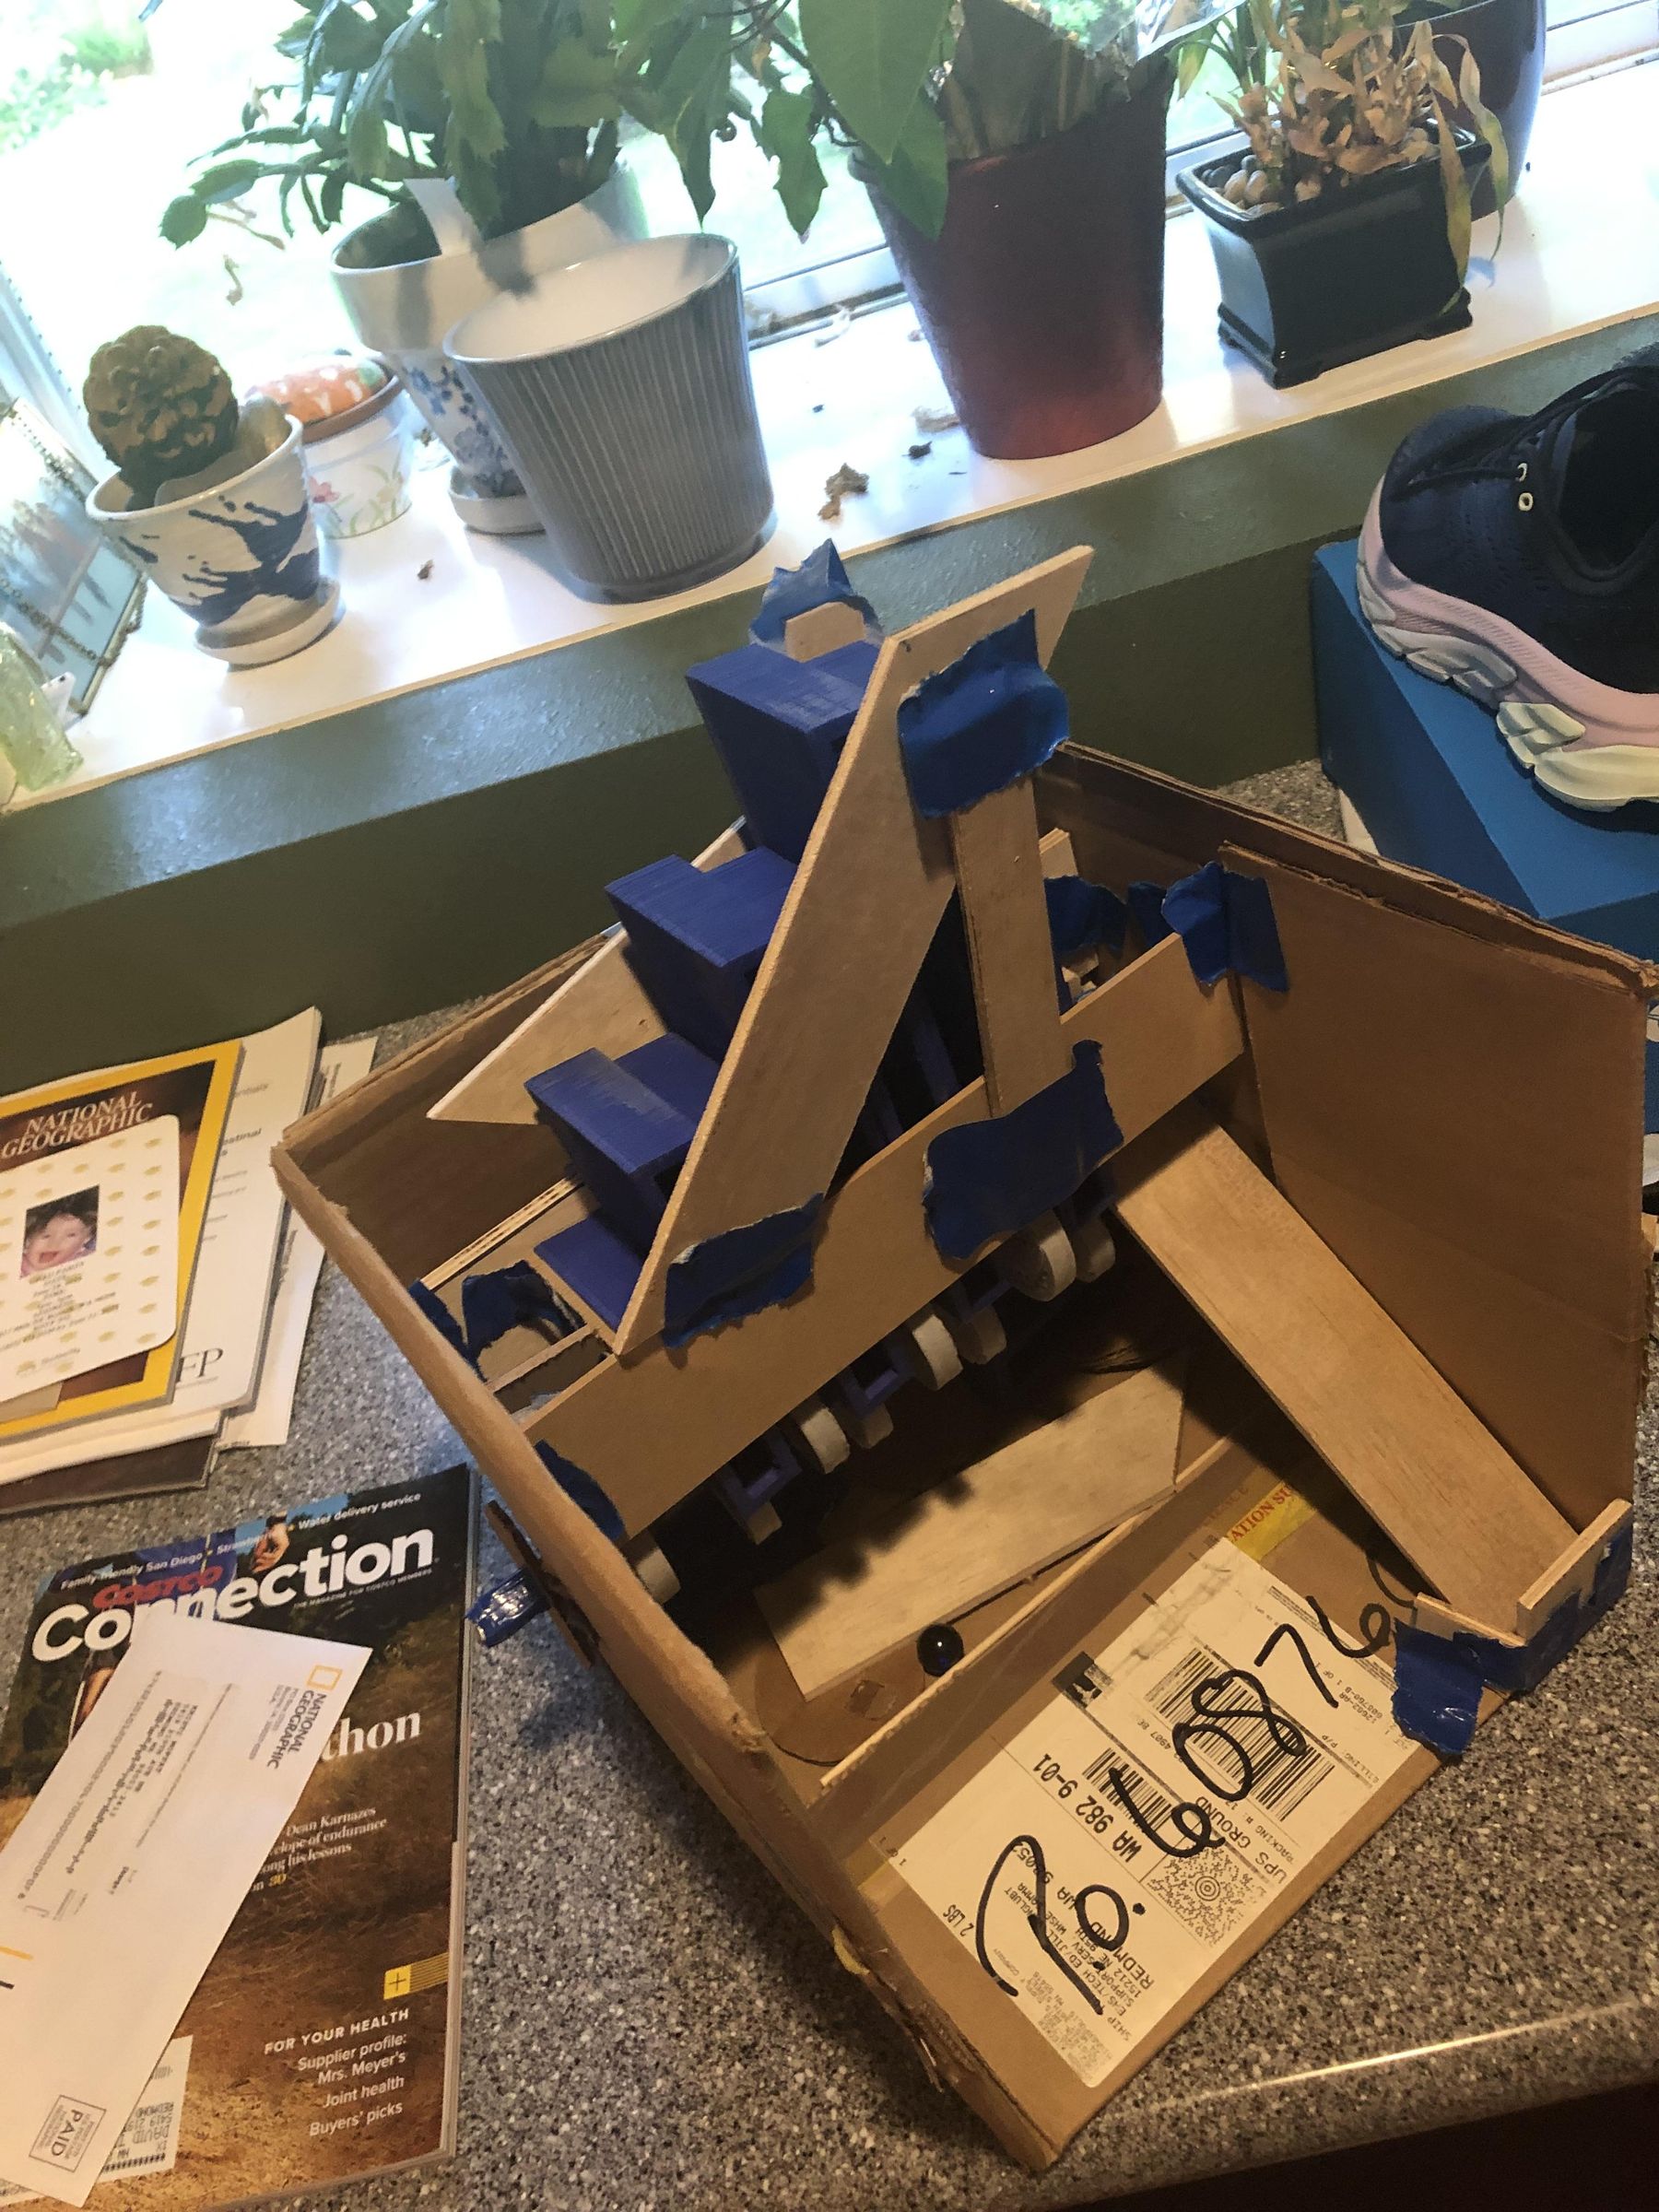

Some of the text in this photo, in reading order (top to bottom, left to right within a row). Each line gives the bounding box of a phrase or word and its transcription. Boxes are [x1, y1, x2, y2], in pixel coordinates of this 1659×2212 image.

[1, 1103, 154, 1159] GEOGRAPHIC
[24, 1090, 142, 1134] NATIONAL
[332, 1500, 381, 1524] delivery
[380, 1490, 422, 1511] service
[1225, 1499, 1276, 1545] ATION
[266, 1689, 314, 1770] GEOGRAPHIC
[287, 1693, 326, 1752] NATIONAL
[321, 1817, 389, 1841] endurance
[1030, 1751, 1143, 1863] WA 982 9-01
[1193, 1793, 1288, 1884] UPS GROUND
[940, 1901, 975, 1937] 2 LBS
[1074, 1925, 1143, 1997] 15212 NE 95TH
[262, 2007, 411, 2055] FOR YOUR HEALTH
[295, 2031, 409, 2073] Supplier profile:
[315, 2050, 408, 2086] Mrs. Meyer's
[320, 2074, 406, 2109] Joint health
[48, 2107, 84, 2159] PAID
[306, 2099, 406, 2139] Buyers' picks
